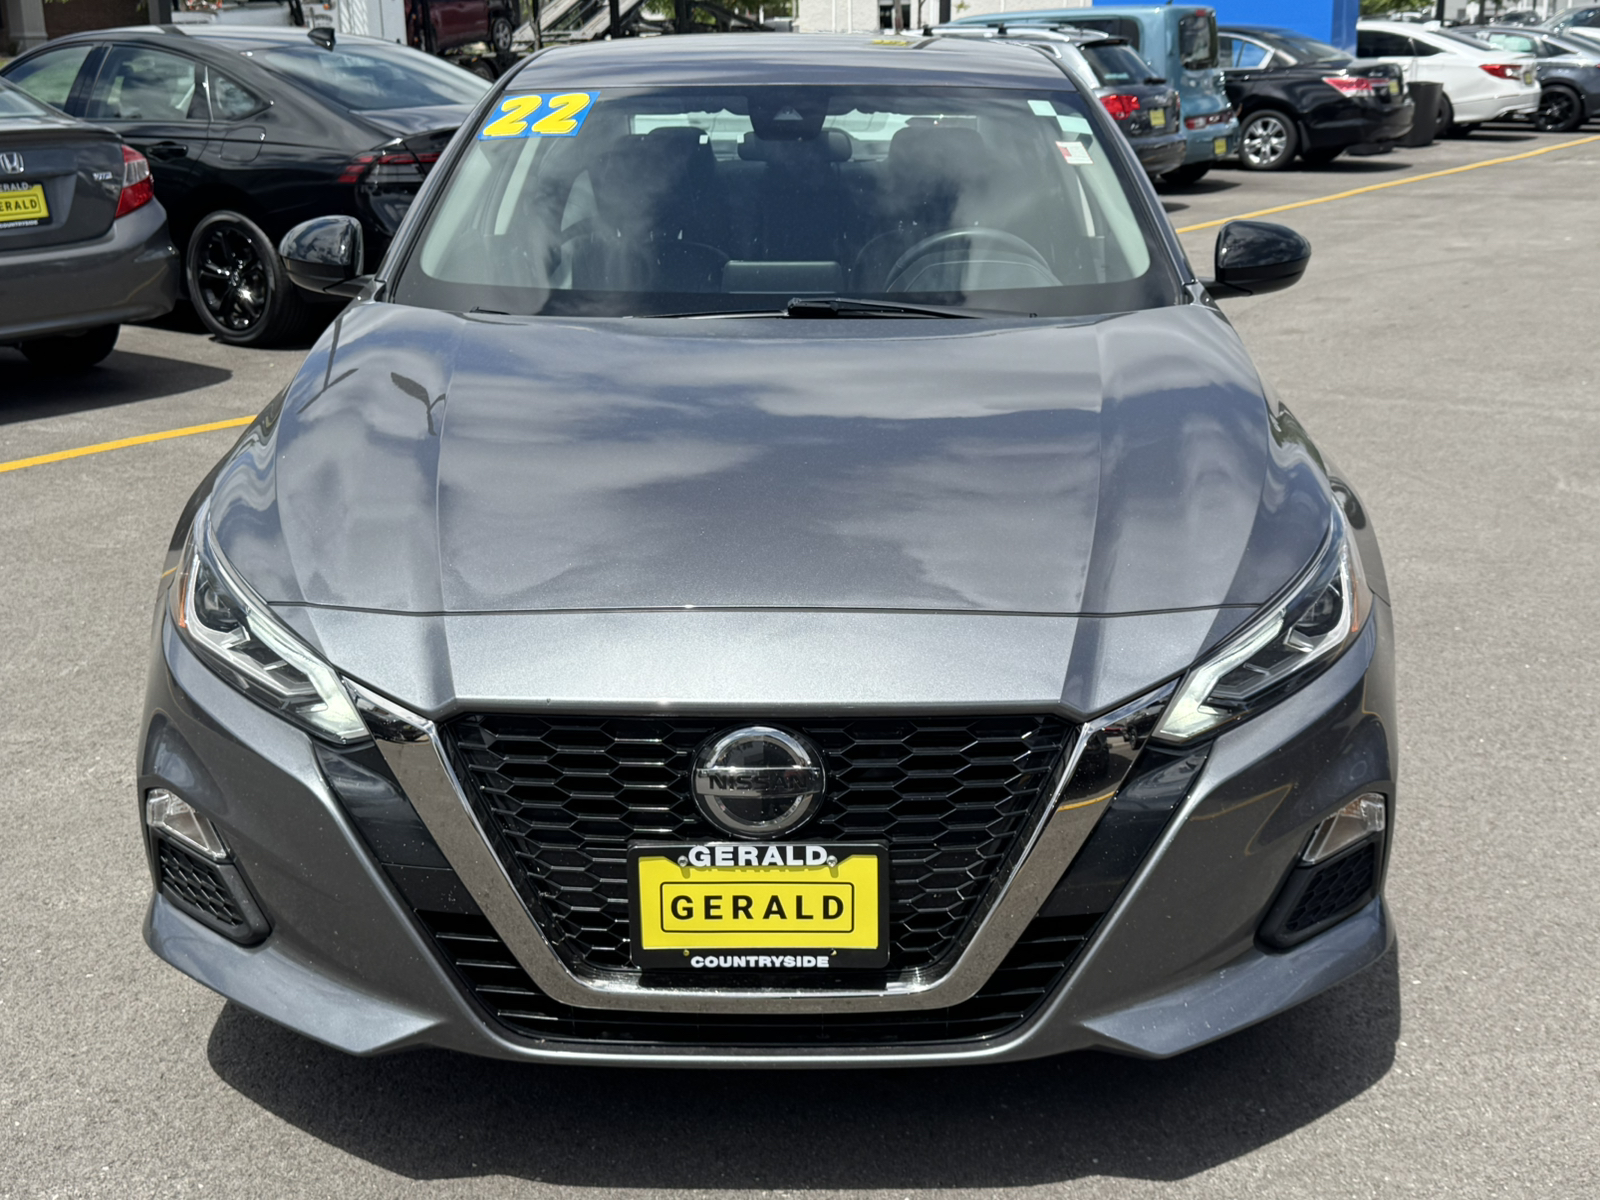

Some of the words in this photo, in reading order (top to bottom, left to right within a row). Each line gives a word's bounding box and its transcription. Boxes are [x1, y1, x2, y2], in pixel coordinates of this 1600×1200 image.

[483, 93, 590, 136] 22
[708, 774, 807, 790] NISSAN
[688, 845, 828, 867] GERALD
[671, 895, 844, 920] GERALD
[691, 956, 830, 968] COUNTRYSIDE
